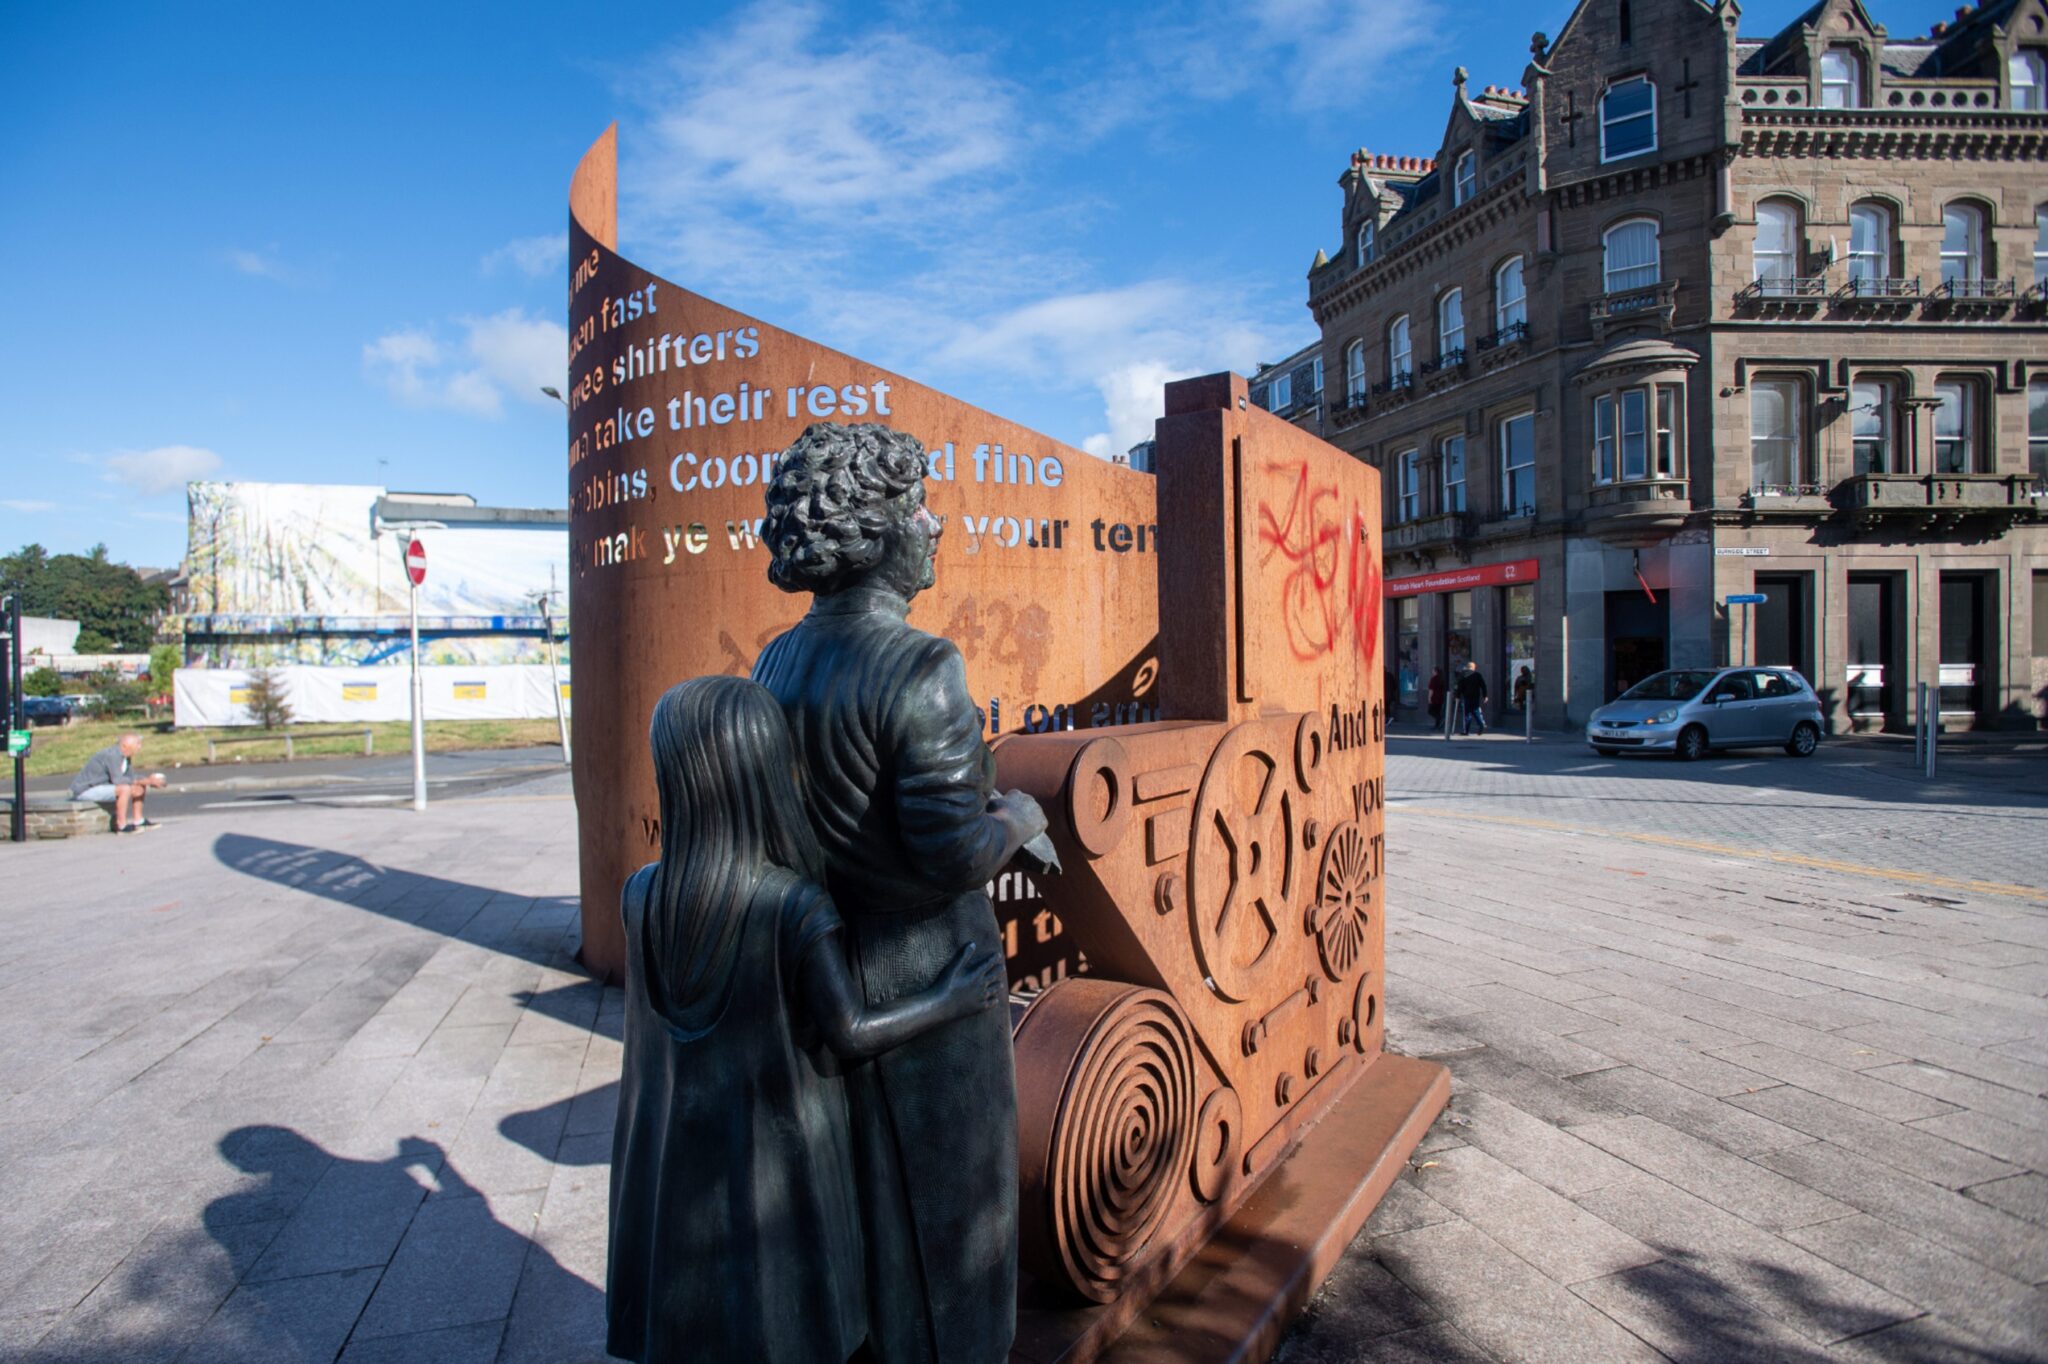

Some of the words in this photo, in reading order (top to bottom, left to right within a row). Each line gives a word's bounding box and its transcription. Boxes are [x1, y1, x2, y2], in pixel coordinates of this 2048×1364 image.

[601, 281, 657, 333] fast
[612, 326, 760, 387] shifters
[595, 407, 656, 451] take
[667, 382, 772, 431] their
[787, 379, 892, 419] rest
[972, 443, 1064, 487] fine
[592, 525, 648, 567] mak
[661, 522, 709, 565] ye
[962, 514, 1069, 556] your
[1410, 581, 1424, 590] Heart
[1425, 577, 1456, 588] Foundation
[1457, 573, 1480, 584] Scotland
[1327, 699, 1367, 754] And
